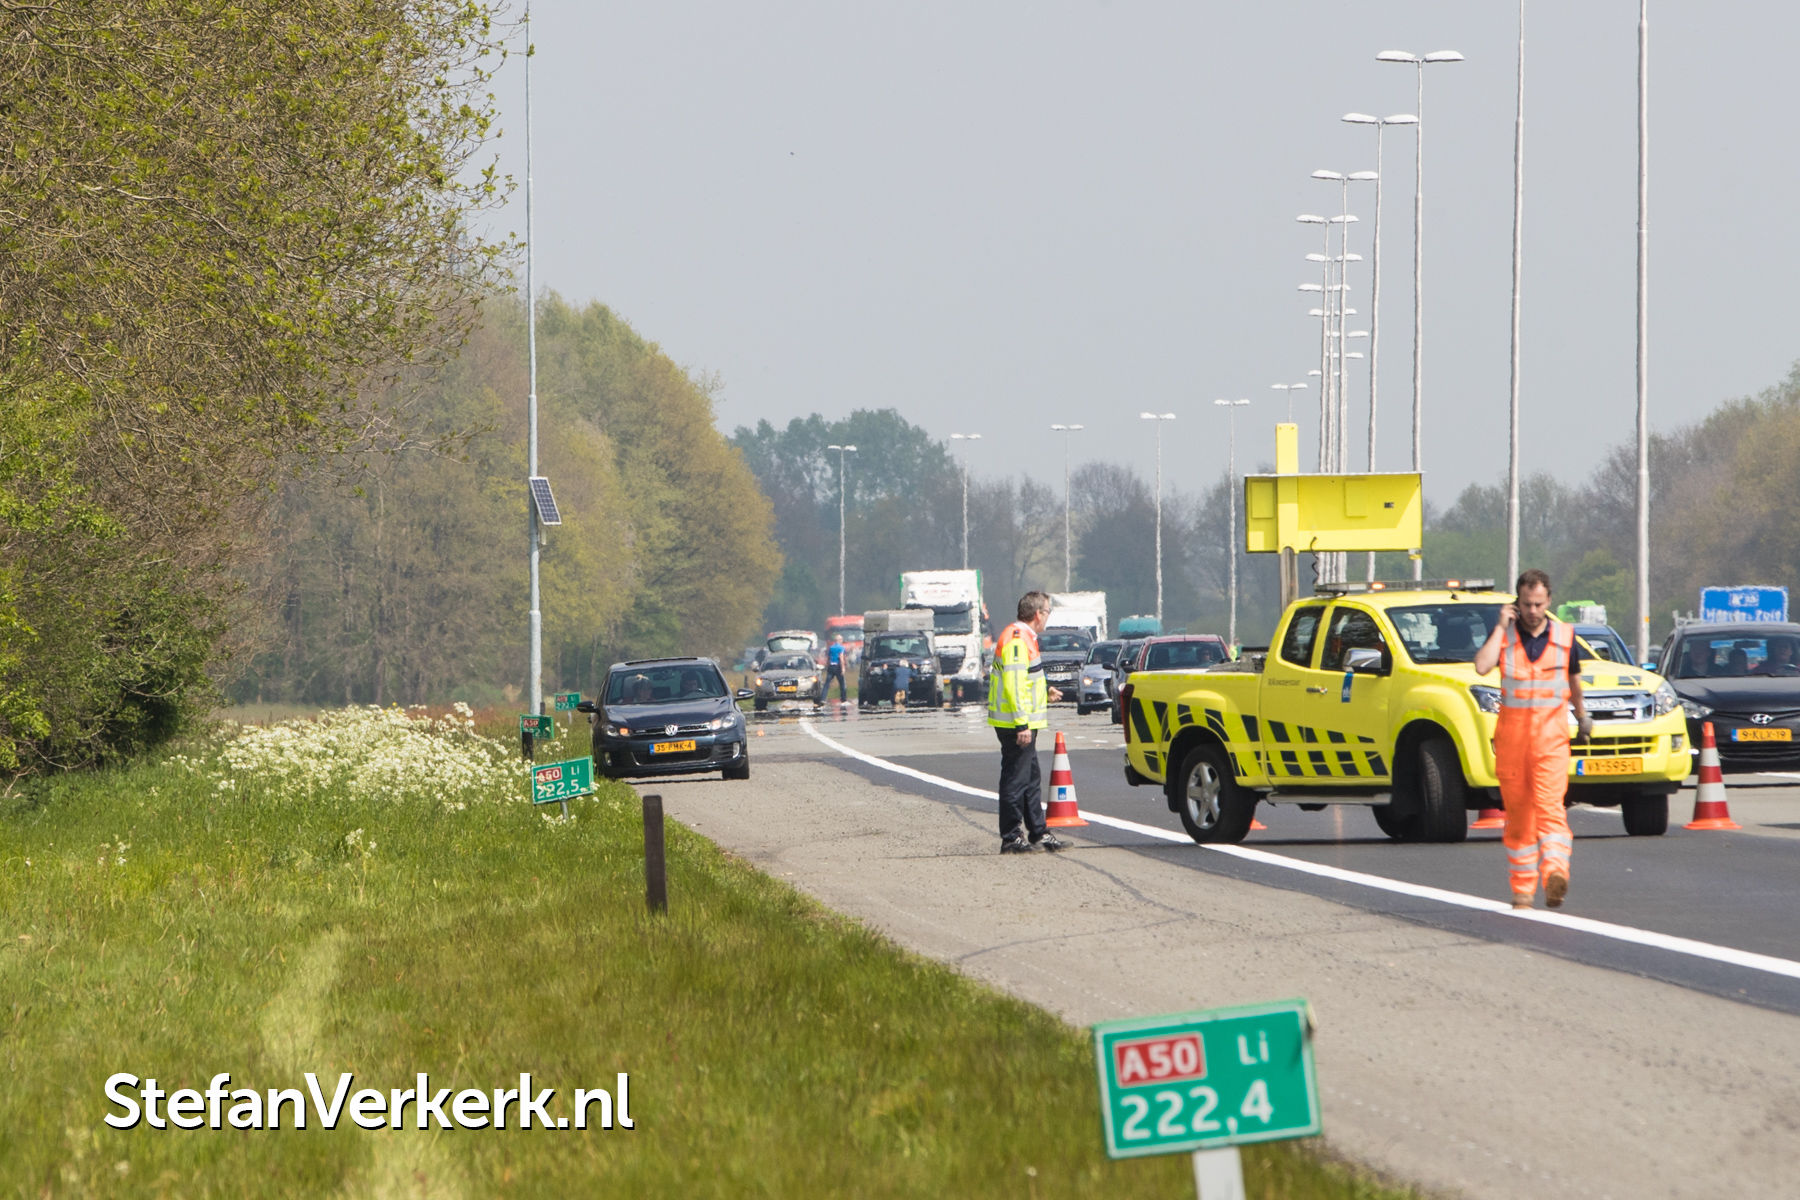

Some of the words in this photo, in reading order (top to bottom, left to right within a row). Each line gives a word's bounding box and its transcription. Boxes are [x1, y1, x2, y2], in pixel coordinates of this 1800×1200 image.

[536, 769, 561, 783] A50
[536, 779, 580, 799] 222,5
[1120, 1039, 1199, 1082] A50
[1236, 1029, 1270, 1065] Li
[1120, 1078, 1274, 1141] 222,4
